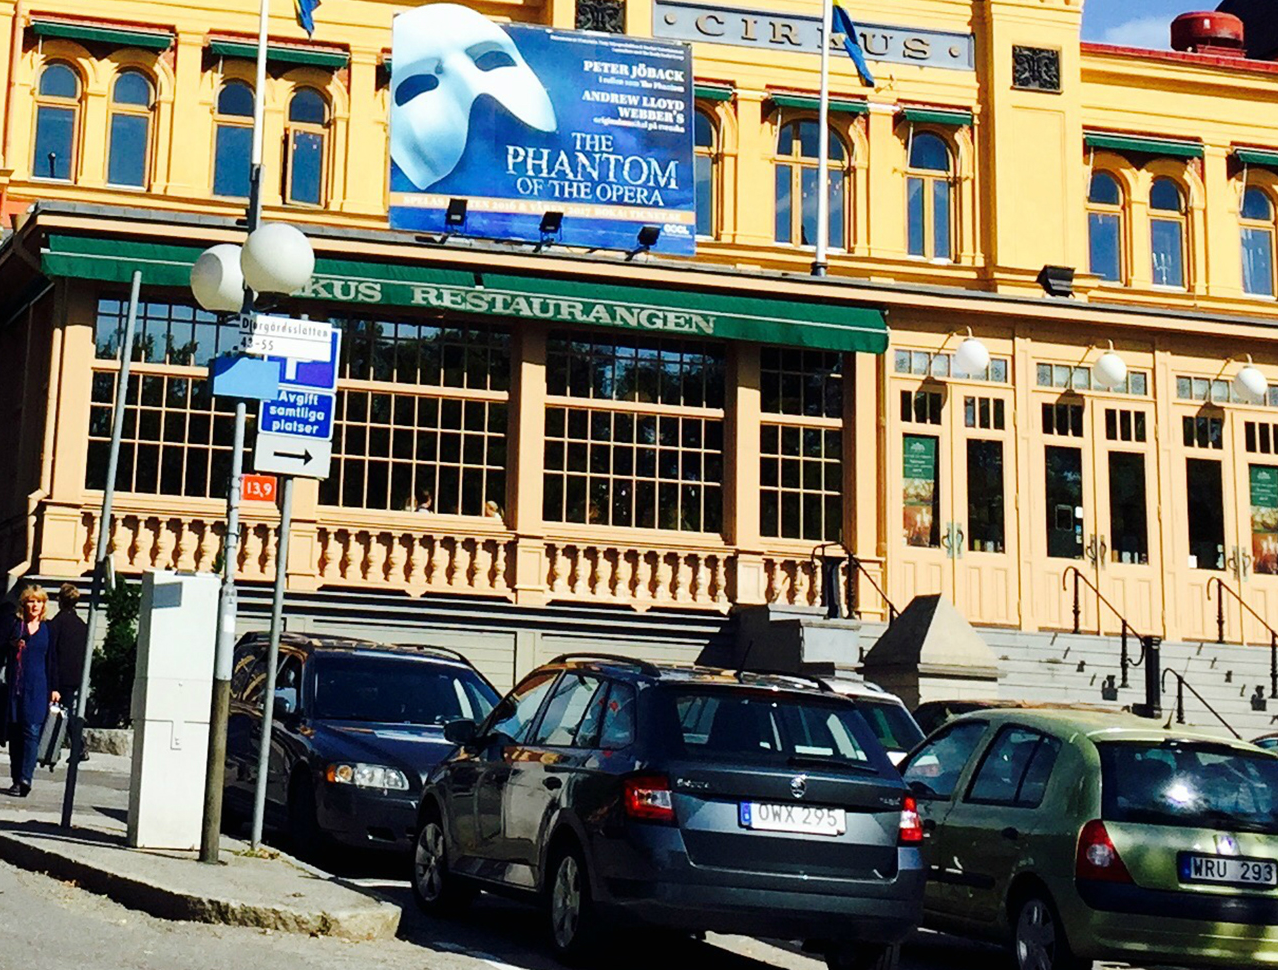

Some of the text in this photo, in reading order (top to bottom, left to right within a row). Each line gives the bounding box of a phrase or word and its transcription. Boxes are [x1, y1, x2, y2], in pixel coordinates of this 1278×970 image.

[583, 60, 685, 82] PETER JÖBACK
[582, 90, 685, 111] ANDREW LLOYD
[618, 106, 685, 124] WEBBER'S
[572, 132, 614, 152] THE
[505, 145, 679, 190] PHANTOM
[516, 177, 665, 206] OF THE OPERA
[290, 277, 716, 334] KUS RESTAURANGEN
[278, 391, 319, 406] Avgift
[269, 405, 325, 422] samtliga
[272, 419, 320, 434] platser
[758, 803, 838, 827] OWX 295
[1193, 857, 1273, 882] WRU 293
